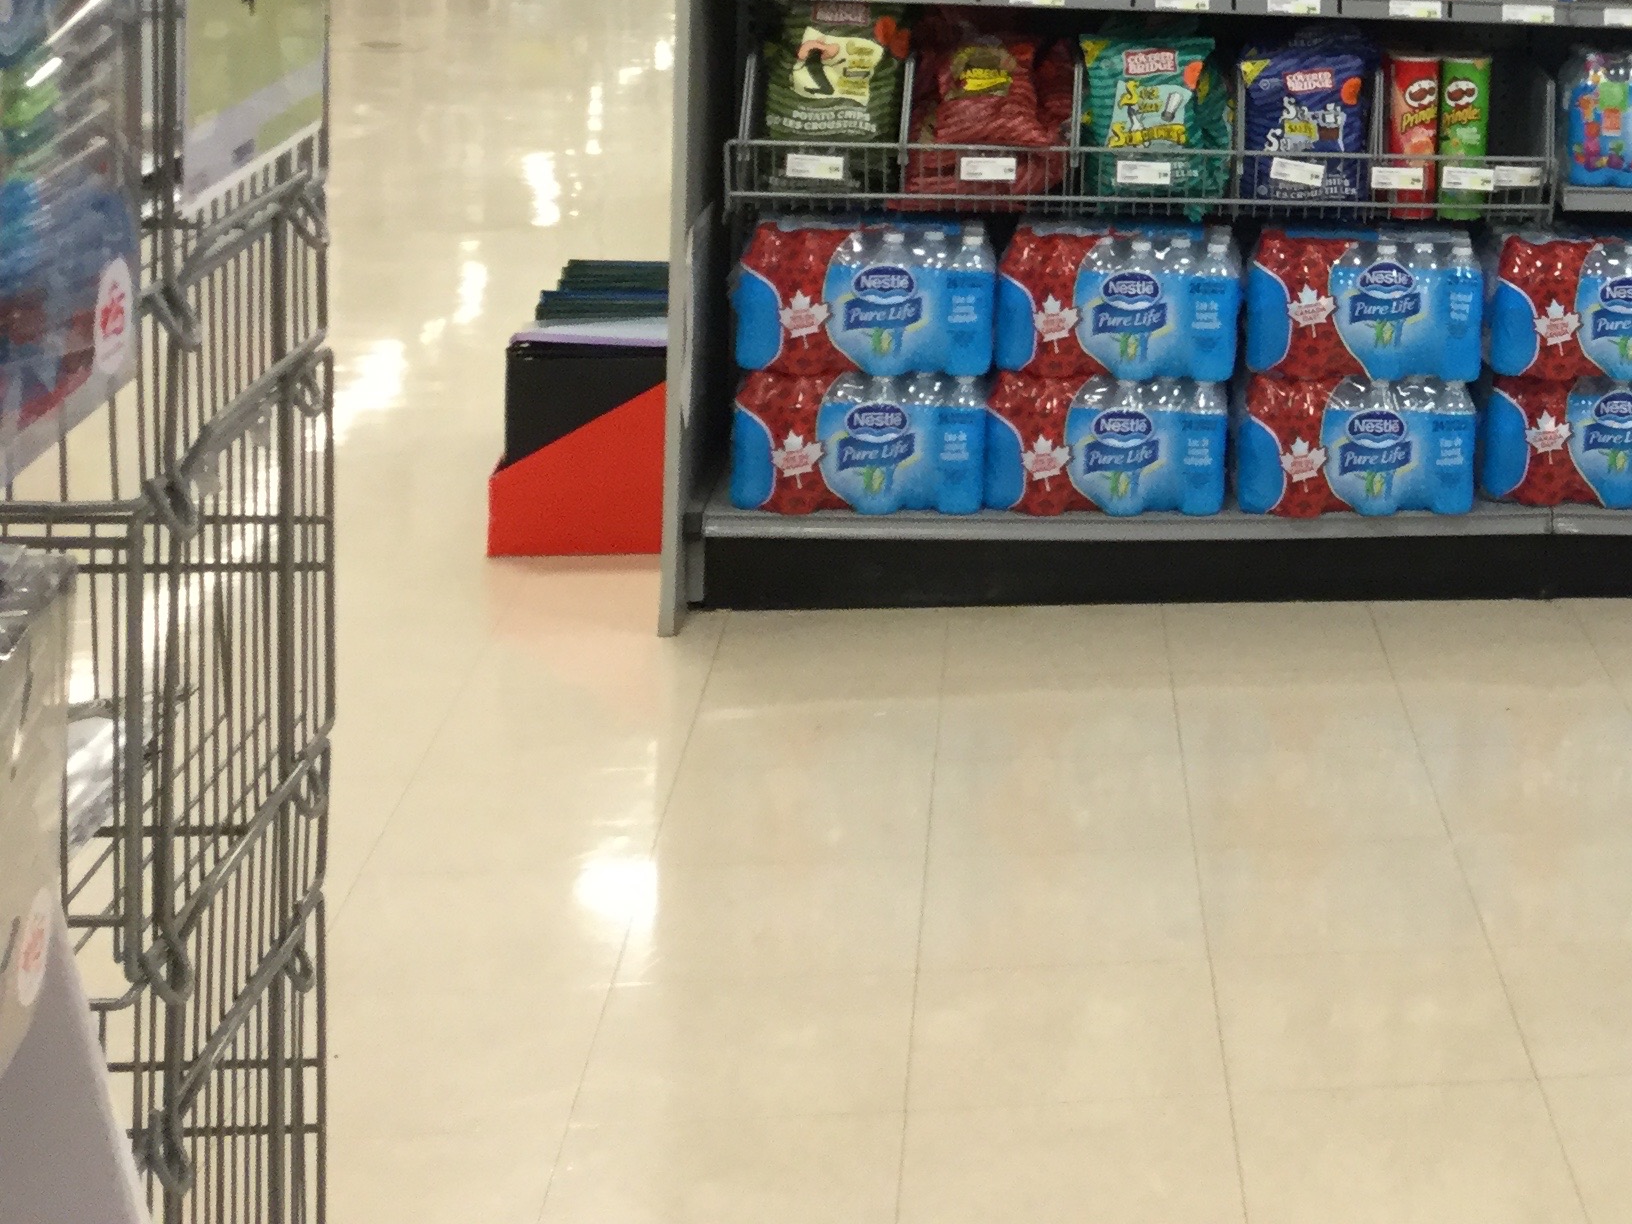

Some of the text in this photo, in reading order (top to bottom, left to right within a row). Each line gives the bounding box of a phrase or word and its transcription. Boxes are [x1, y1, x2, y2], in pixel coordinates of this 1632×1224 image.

[850, 302, 917, 323] Pure Life
[1098, 307, 1162, 327] Pure Life
[1354, 298, 1416, 317] Pure Life
[1596, 316, 1632, 333] Pure
[1589, 430, 1623, 445] Pure
[841, 440, 911, 464] Pure Life
[1089, 446, 1155, 468] Pure Life
[1343, 446, 1406, 468] Pure Life
